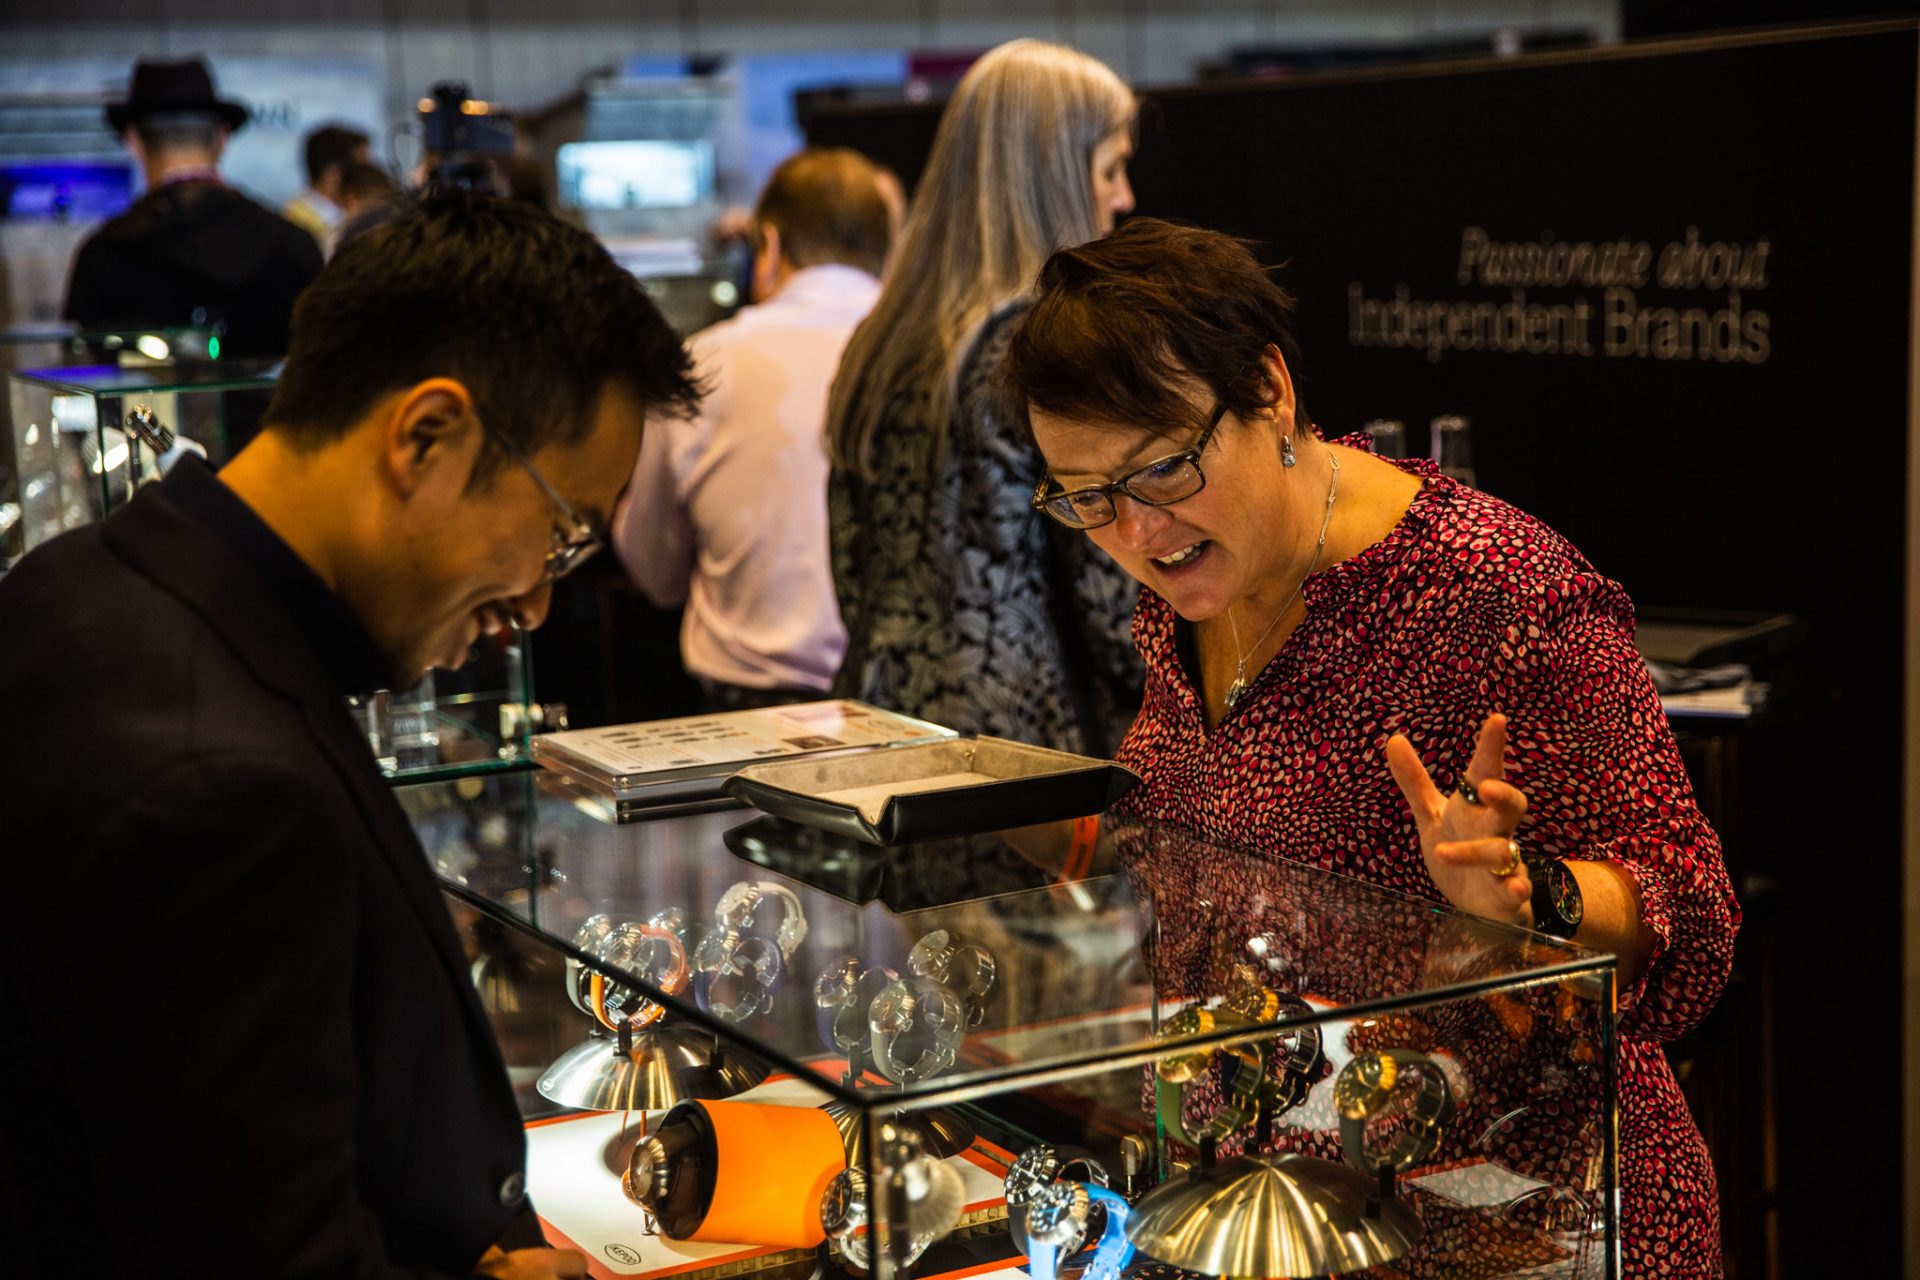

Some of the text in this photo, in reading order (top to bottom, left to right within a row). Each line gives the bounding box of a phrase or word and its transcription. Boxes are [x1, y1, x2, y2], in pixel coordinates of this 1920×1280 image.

[1458, 224, 1771, 290] Passionate about
[1347, 280, 1771, 364] Independent Brands
